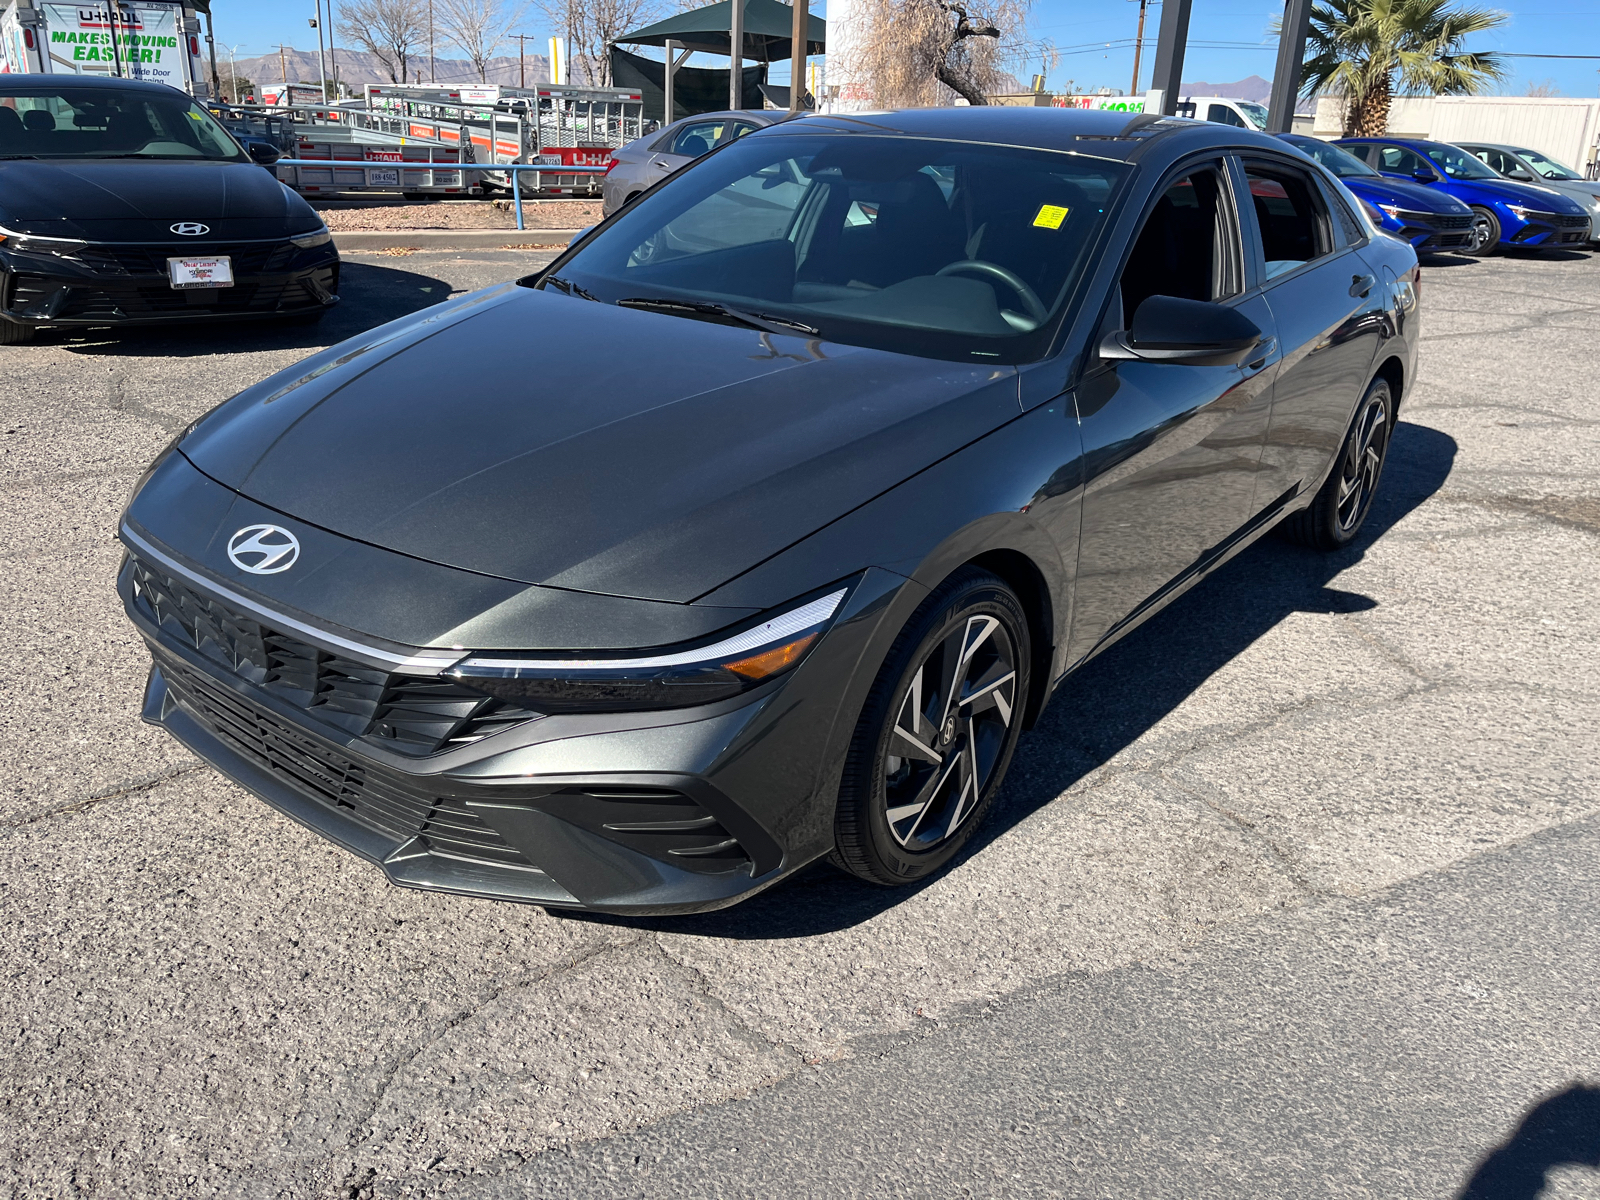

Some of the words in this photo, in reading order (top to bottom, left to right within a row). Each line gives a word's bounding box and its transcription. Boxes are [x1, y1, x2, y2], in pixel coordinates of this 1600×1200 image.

[79, 10, 141, 23] U-HAUL
[52, 31, 110, 45] MAKES
[116, 33, 177, 48] MOVING
[73, 46, 161, 63] EASIER!
[131, 68, 151, 76] Wide
[152, 68, 171, 76] Door
[364, 153, 403, 162] U-HAUL
[573, 153, 613, 165] U-HA
